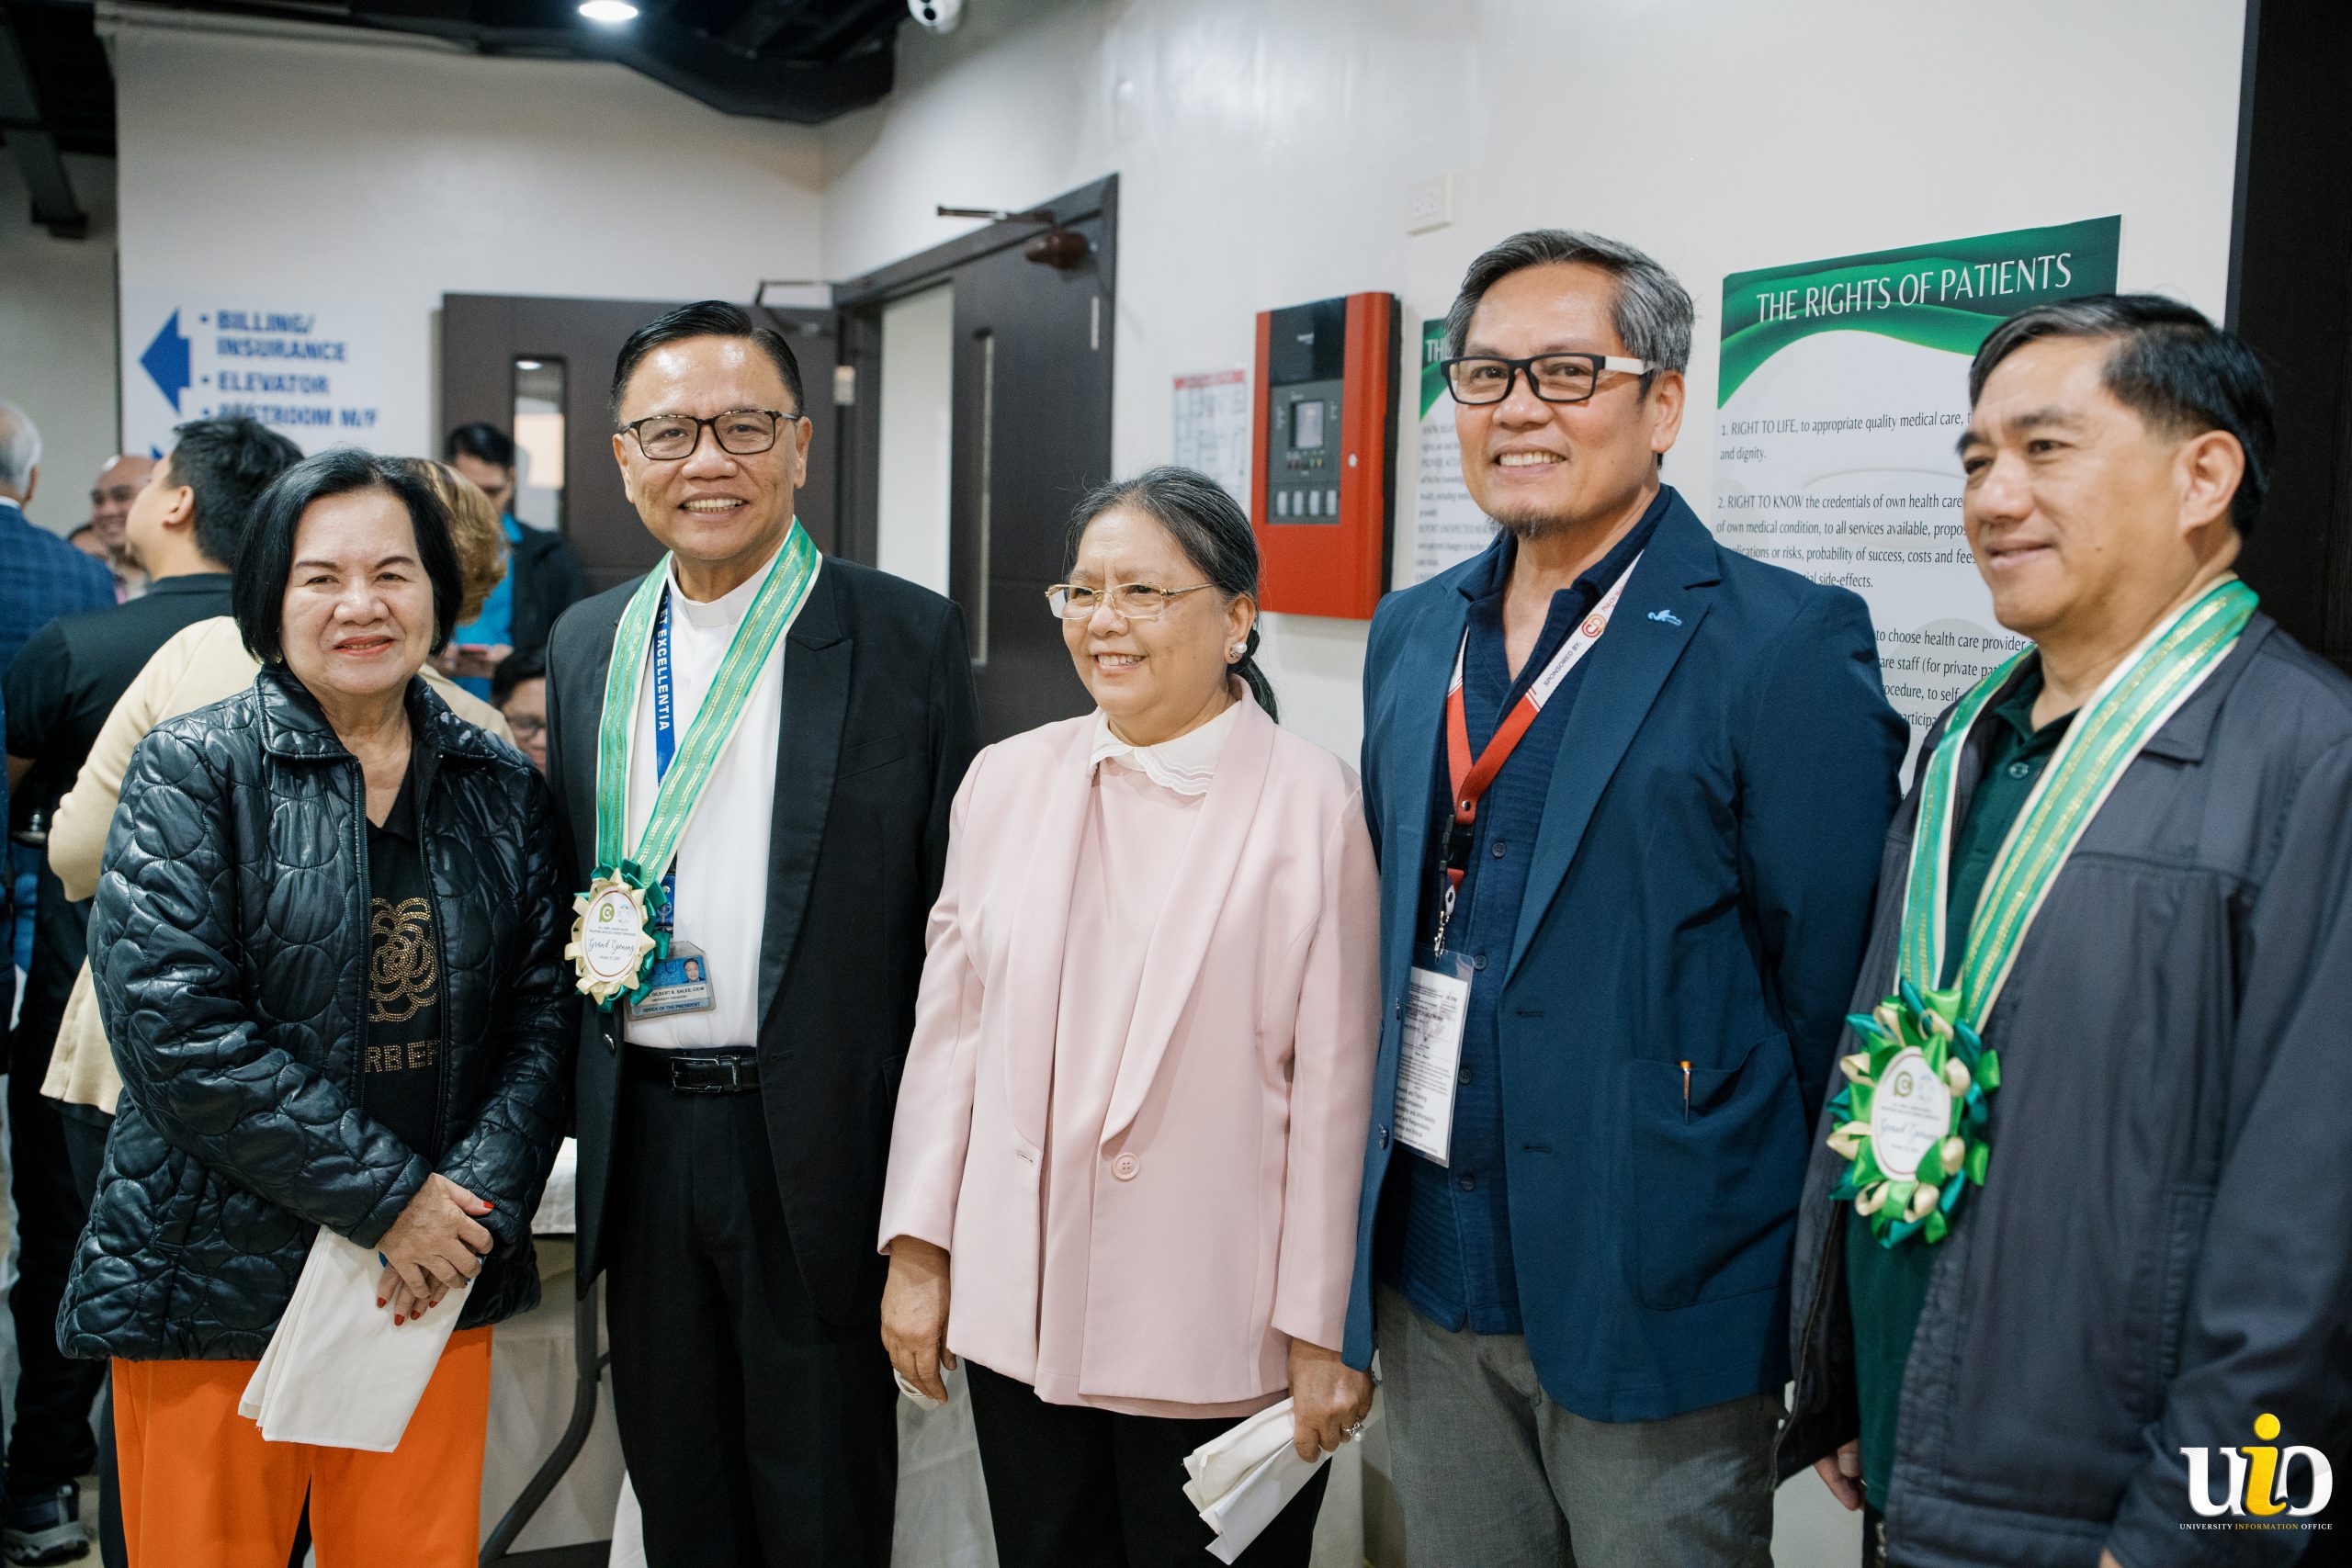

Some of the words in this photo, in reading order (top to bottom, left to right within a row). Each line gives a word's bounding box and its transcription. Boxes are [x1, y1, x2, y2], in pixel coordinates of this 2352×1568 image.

[1756, 289, 1798, 322] THE
[1805, 276, 1891, 318] RIGHTS
[1898, 271, 1934, 307] OF
[1940, 253, 2072, 302] PATIENTS
[219, 310, 314, 333] BILLING/
[218, 338, 345, 359] INSURANCE
[219, 372, 328, 393] ELEVATOR
[1721, 424, 1729, 436] 1.
[1731, 420, 1759, 436] RIGHT
[1761, 420, 1775, 434] TO
[1777, 418, 1799, 434] LIFE,
[1801, 422, 1810, 433] to
[1812, 416, 1863, 434] appropriate
[1865, 413, 1896, 433] quality
[1900, 411, 1938, 427] medical
[1939, 412, 1964, 426] care,
[1720, 446, 1735, 461] and
[1736, 446, 1767, 463] dignity.
[1717, 497, 1725, 509] 2.
[1727, 494, 1756, 509] RIGHT
[1758, 494, 1771, 509] TO
[1773, 494, 1804, 509] KNOW
[1805, 494, 1820, 509] the
[1822, 493, 1871, 509] credentials
[1872, 493, 1884, 509] of
[1885, 497, 1906, 509] own
[1908, 493, 1939, 508] health
[1941, 496, 1963, 508] care
[1716, 519, 1726, 533] of
[1726, 523, 1744, 533] own
[1747, 519, 1778, 534] medical
[1780, 520, 1822, 536] condition,
[1825, 523, 1834, 535] to
[1836, 520, 1847, 535] all
[1849, 521, 1884, 535] services
[1886, 520, 1930, 536] available,
[1771, 547, 1781, 558] or
[1782, 546, 1804, 560] risks,
[1806, 546, 1853, 564] probability
[1856, 547, 1867, 561] of
[1868, 551, 1905, 564] success,
[1907, 551, 1932, 563] costs
[1935, 548, 1953, 563] and
[1819, 571, 1873, 588] side-effects.
[1876, 630, 1885, 641] to
[1888, 628, 1921, 644] choose
[1925, 630, 1955, 647] health
[1958, 636, 1979, 649] care
[1982, 636, 2026, 652] provider
[1544, 651, 1574, 687] SPONSORED
[1897, 657, 1921, 671] staff
[1922, 657, 1940, 674] (for
[1943, 660, 1977, 678] private
[657, 629, 670, 731] EXCELLENTIA
[1928, 688, 1938, 700] to
